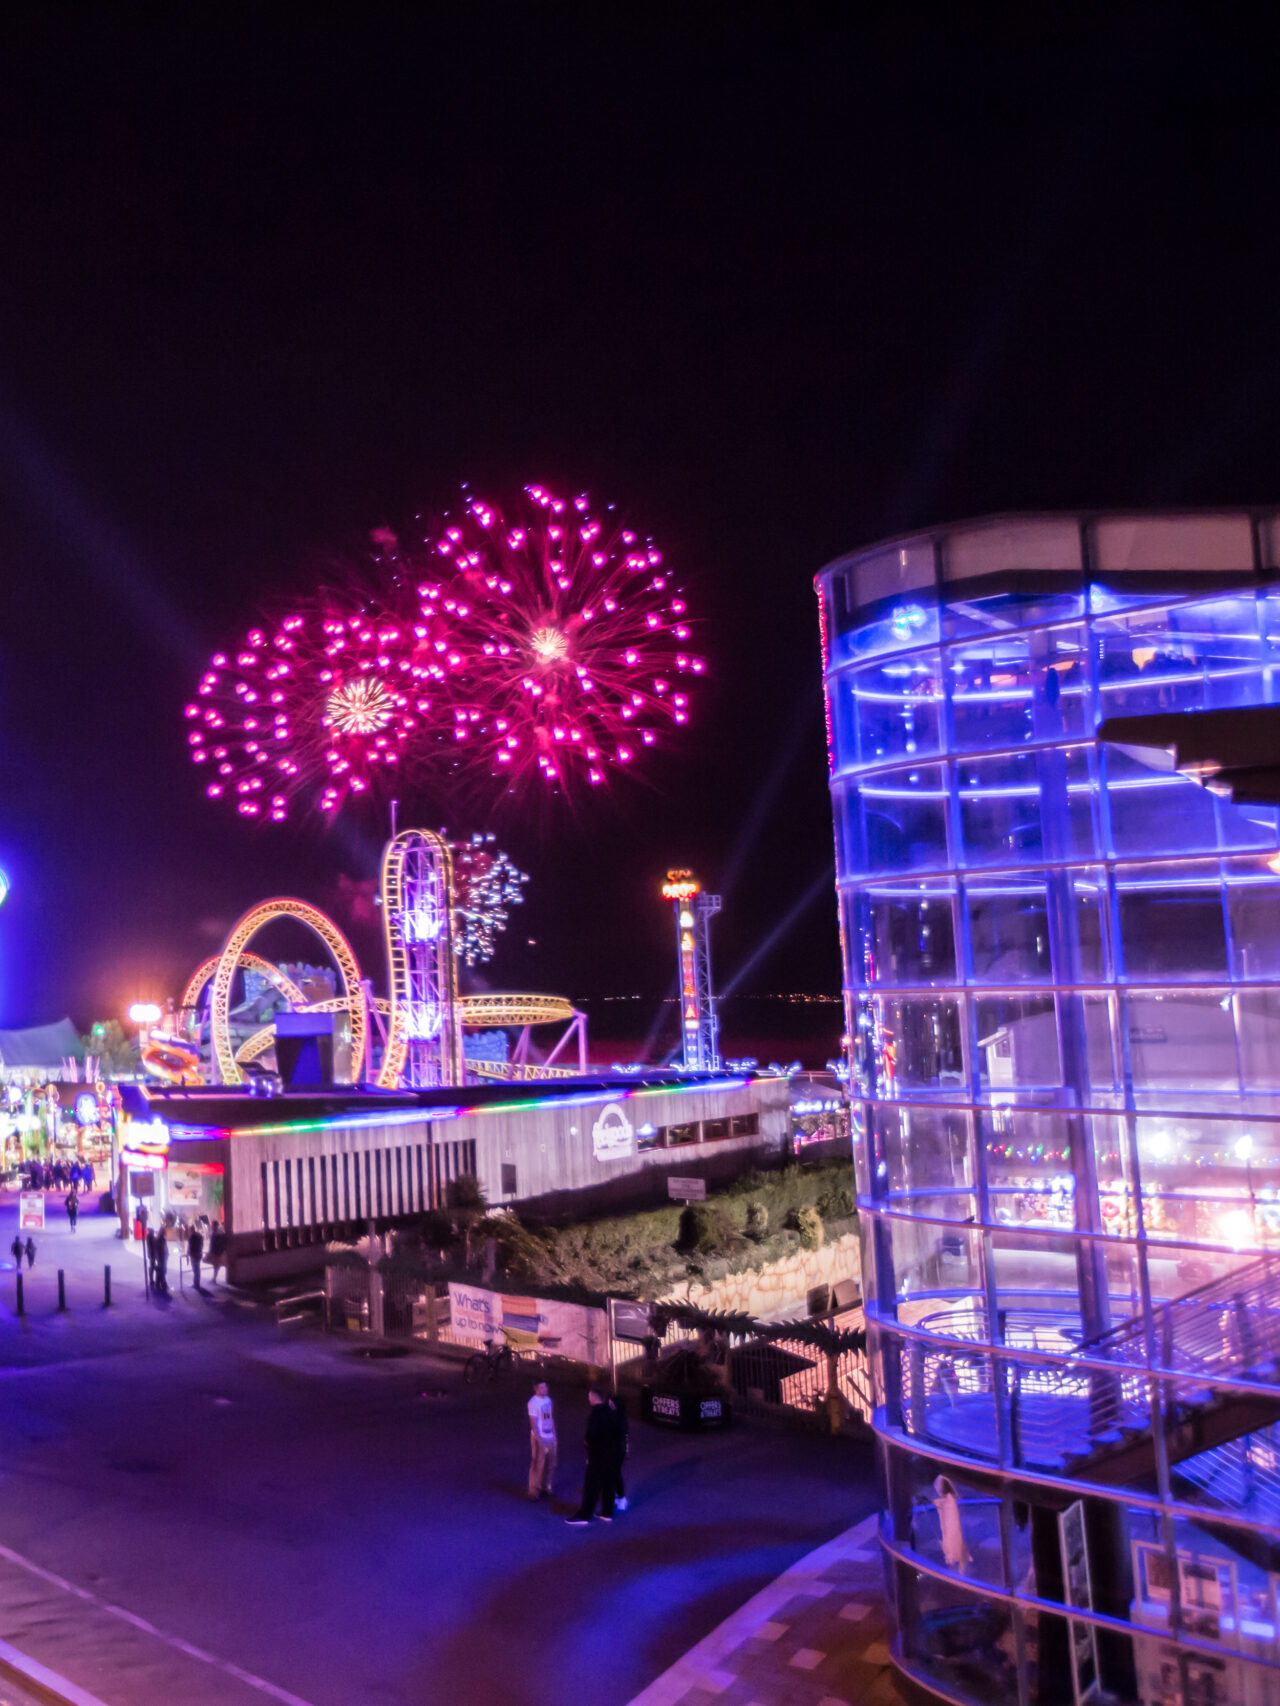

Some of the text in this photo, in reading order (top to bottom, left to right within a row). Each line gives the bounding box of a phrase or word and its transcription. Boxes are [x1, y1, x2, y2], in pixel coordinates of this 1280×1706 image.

[454, 1292, 490, 1313] What's
[652, 1396, 680, 1409] OFFERS
[700, 1400, 722, 1411] OFFERS
